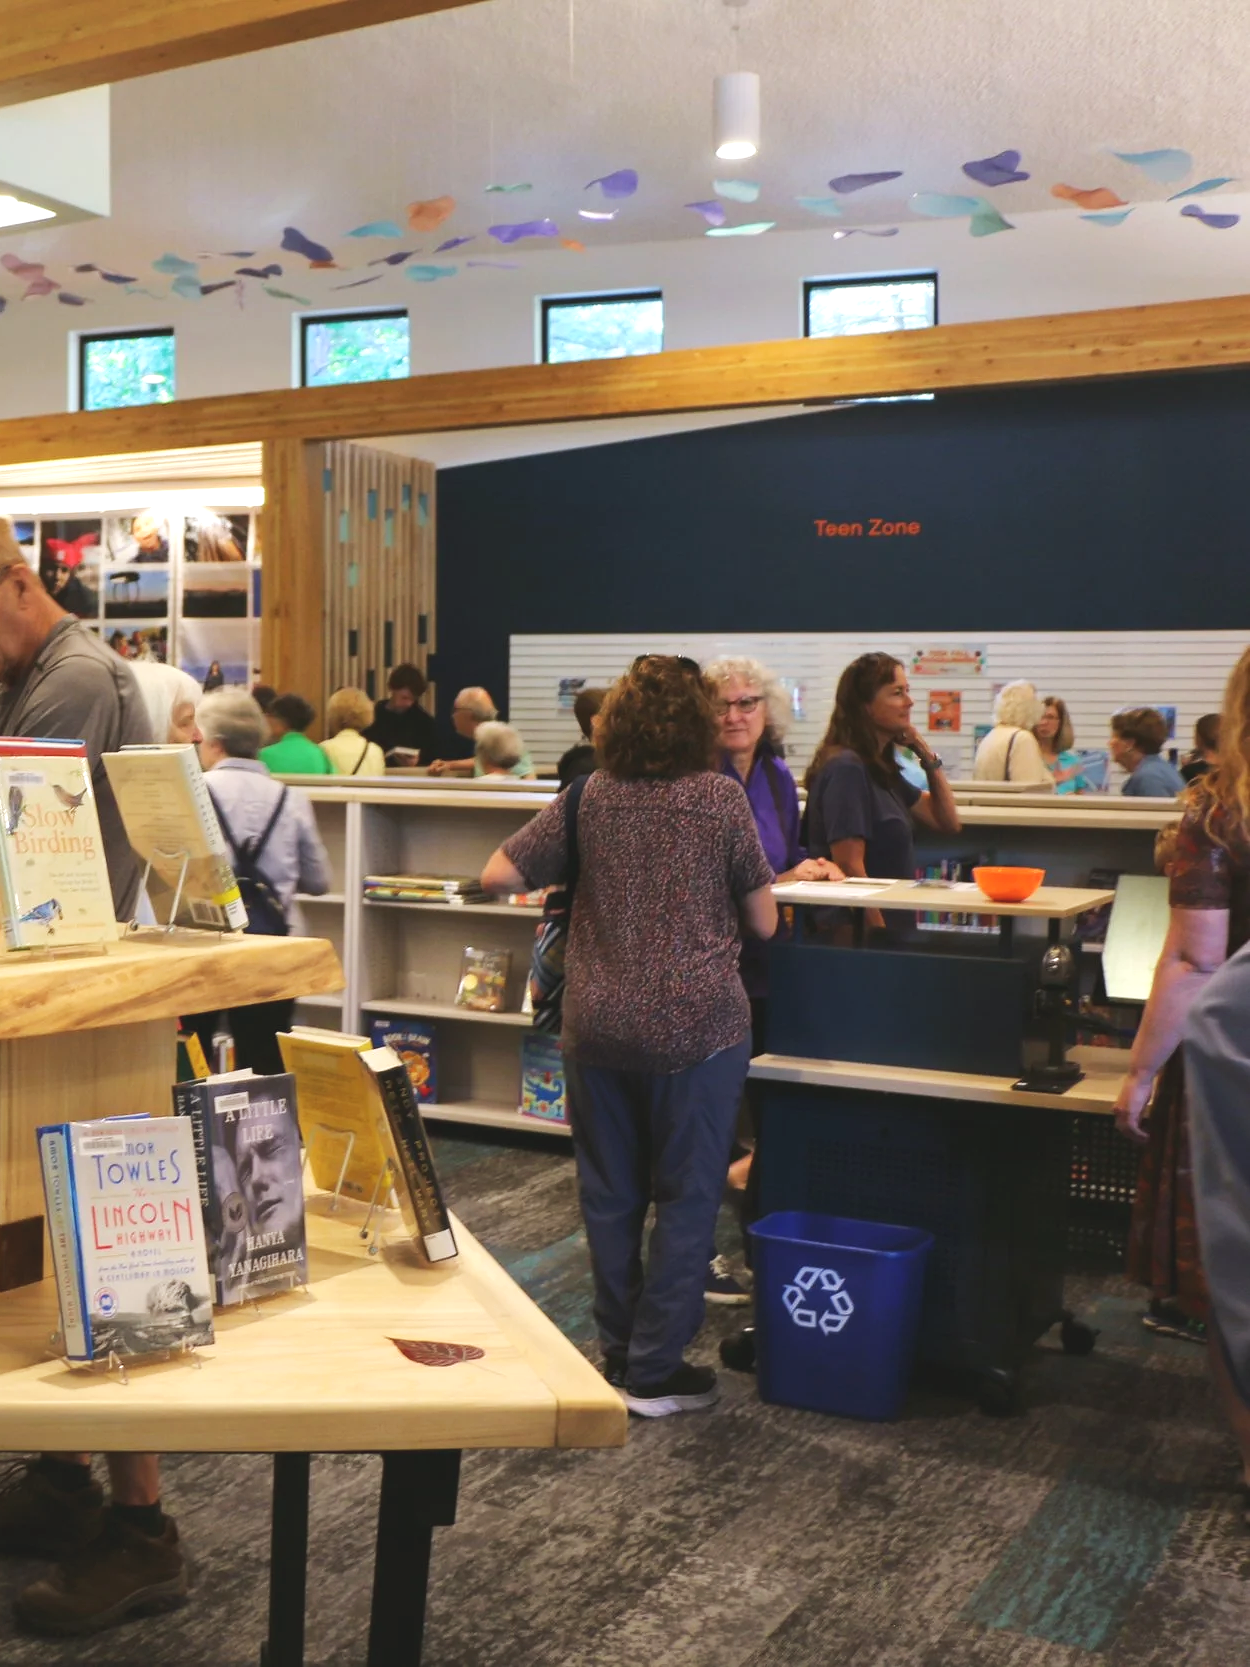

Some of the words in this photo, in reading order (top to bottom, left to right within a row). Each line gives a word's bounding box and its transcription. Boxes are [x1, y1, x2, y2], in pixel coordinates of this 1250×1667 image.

[814, 519, 863, 536] Teen
[868, 518, 921, 536] Zone
[22, 803, 76, 828] Slow
[14, 831, 96, 860] Birding
[224, 1109, 235, 1122] A
[239, 1098, 288, 1120] LITTLE
[242, 1124, 274, 1143] LIFE
[91, 1149, 181, 1190] TOWLES
[91, 1198, 194, 1250] LINCOLN
[116, 1229, 172, 1245] HIGHWAY
[246, 1230, 286, 1251] HANYA
[228, 1248, 304, 1278] YANAGIHARA
